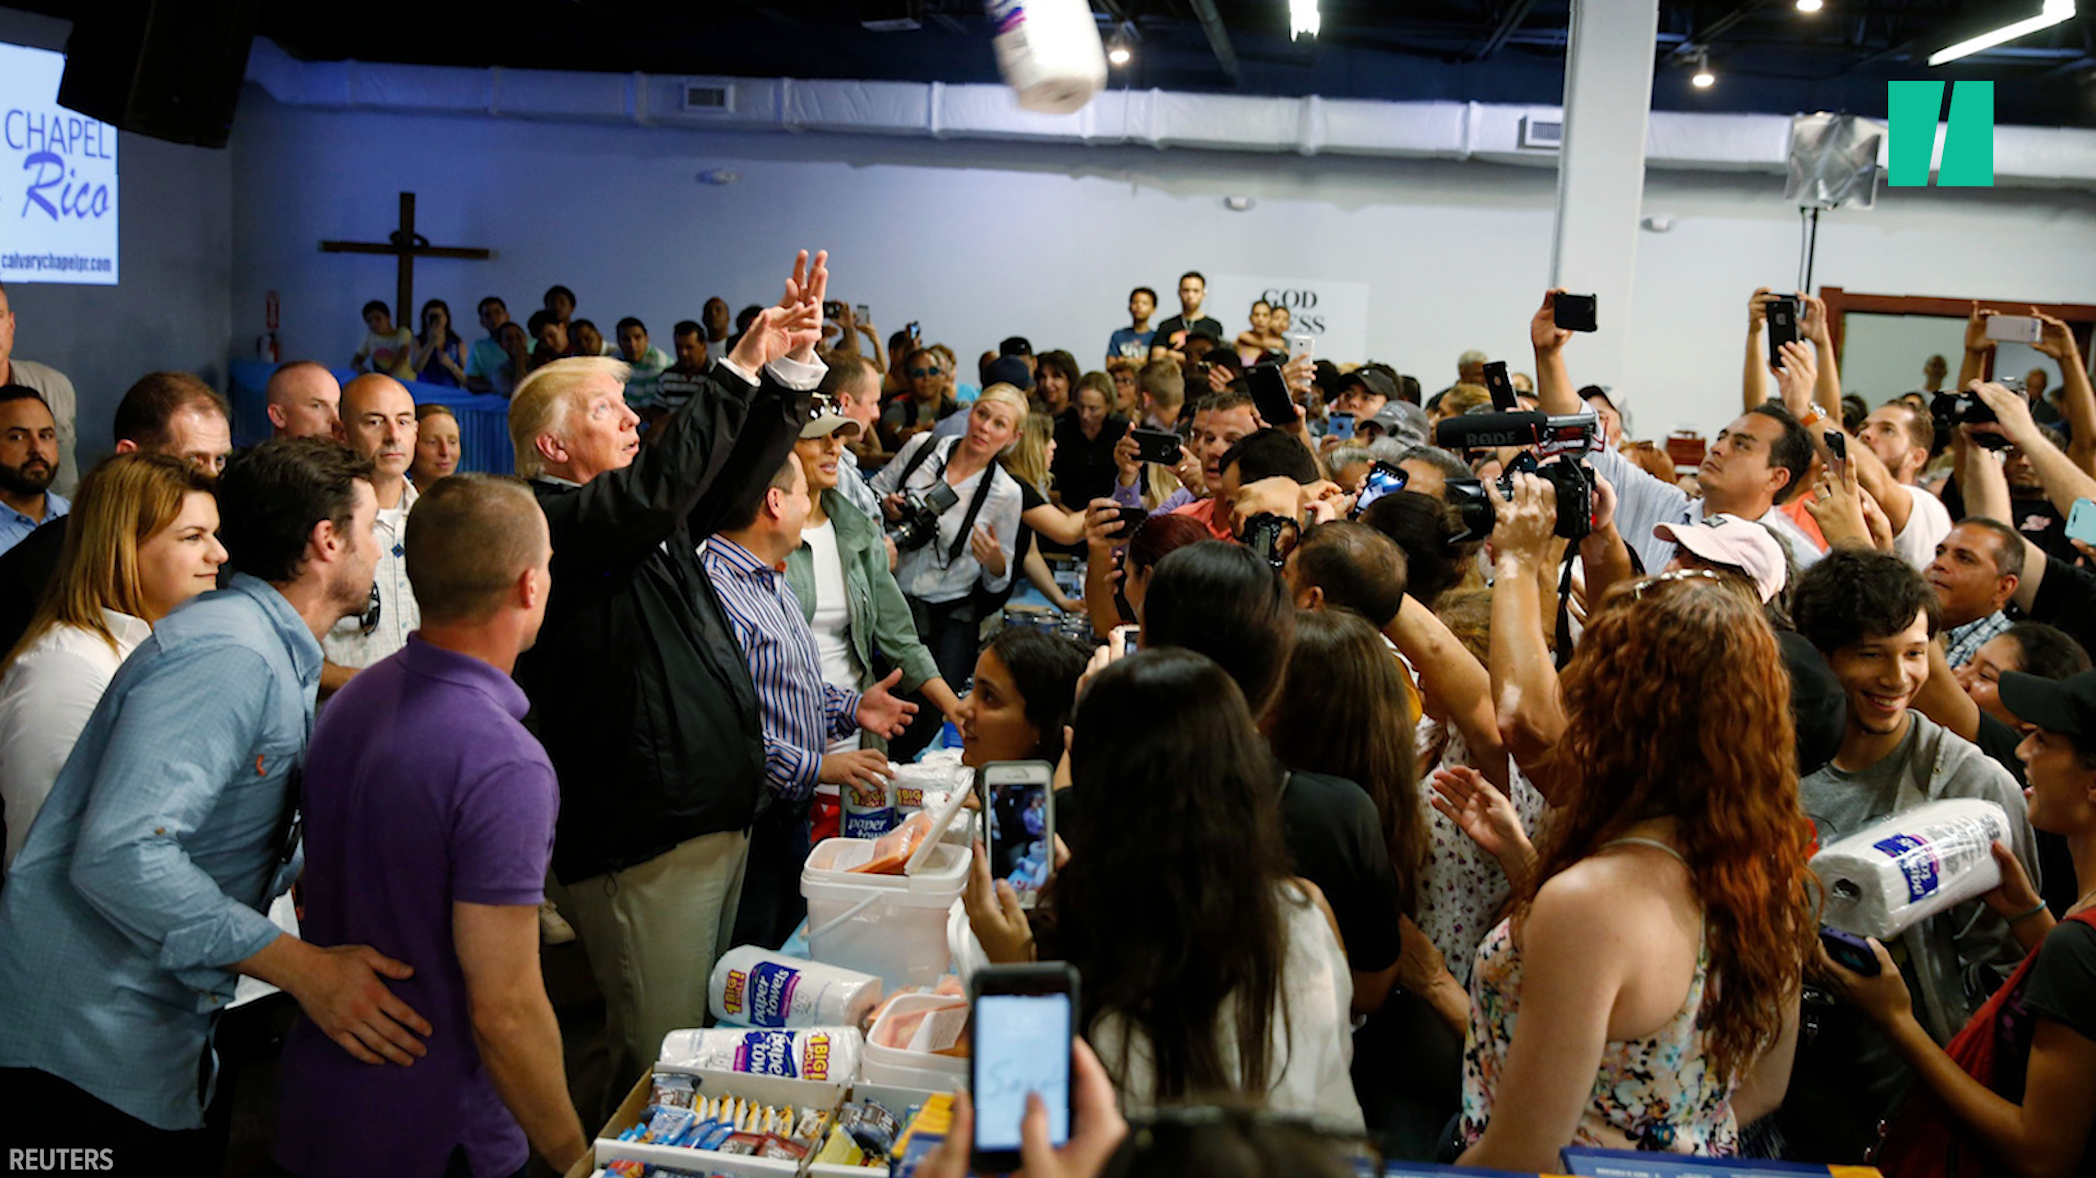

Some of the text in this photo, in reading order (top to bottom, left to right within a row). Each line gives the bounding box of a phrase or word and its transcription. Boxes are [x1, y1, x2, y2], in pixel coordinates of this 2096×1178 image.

[5, 109, 112, 160] CHAPEL
[22, 151, 109, 222] Rico
[1262, 288, 1318, 310] GOD
[1289, 313, 1326, 335] ESS
[848, 818, 887, 832] paper
[754, 976, 770, 1025] paper
[767, 969, 790, 1017] towels
[751, 1041, 770, 1075] tow
[766, 1032, 787, 1077] pape
